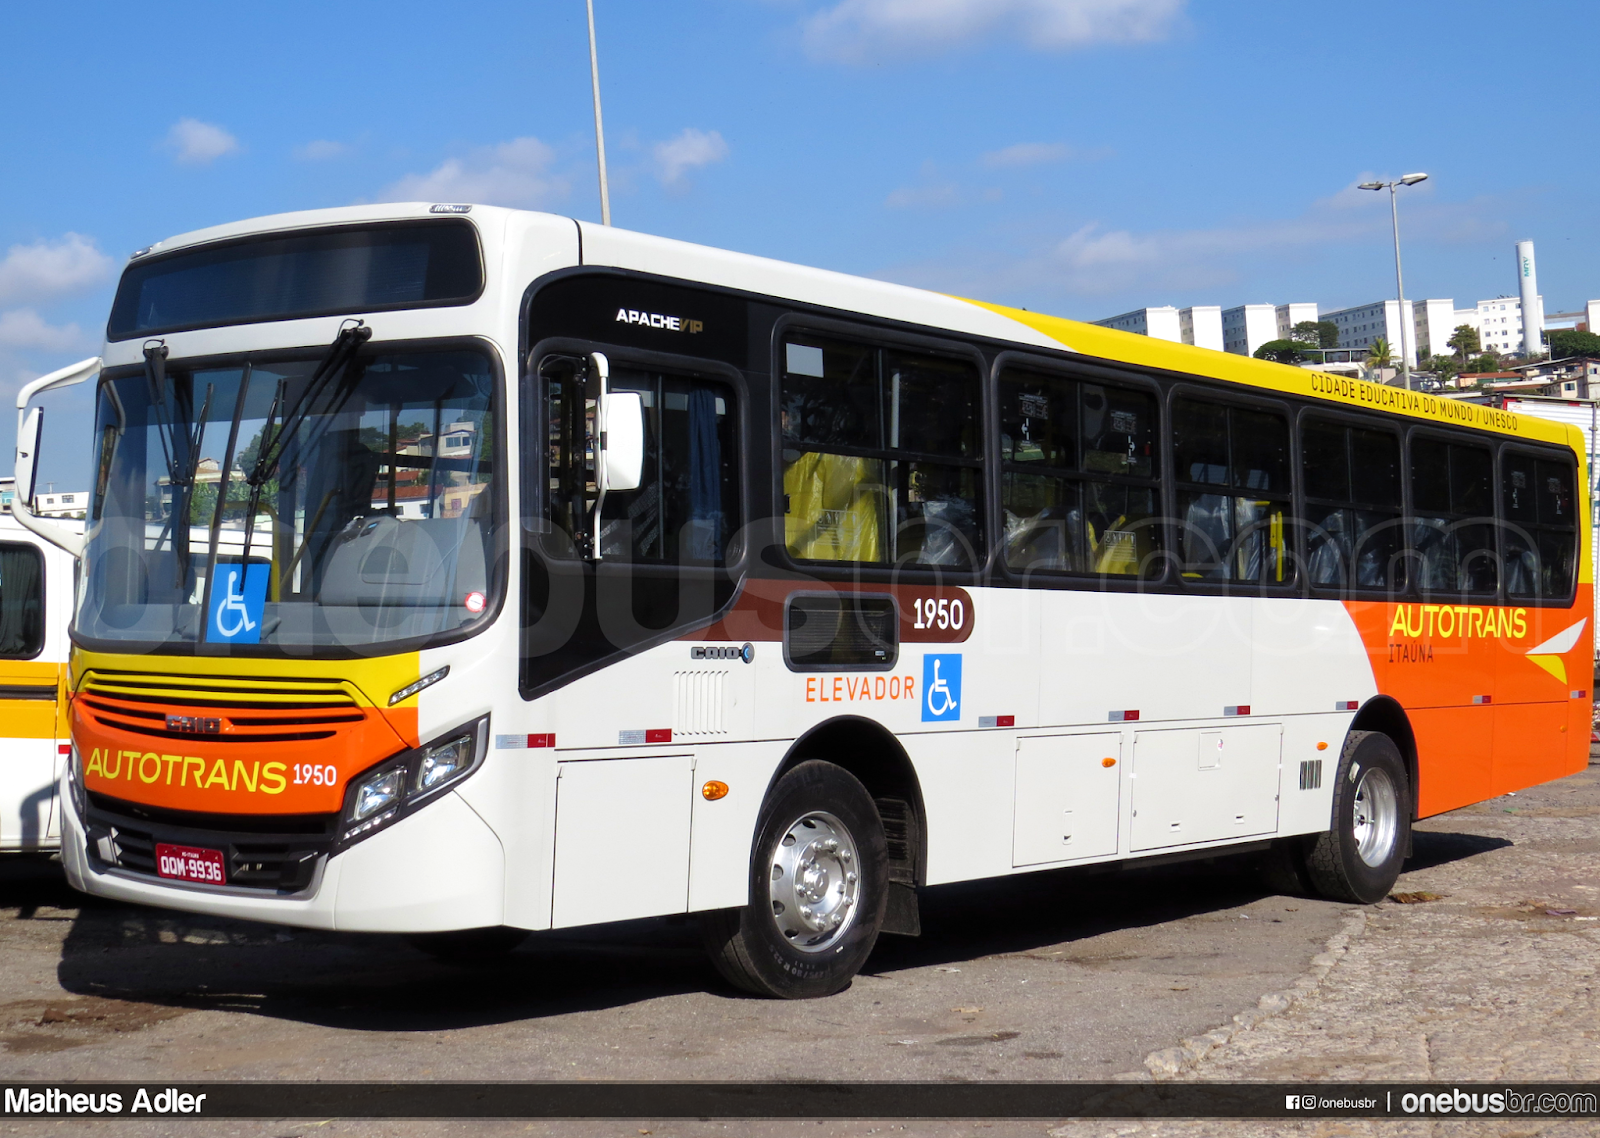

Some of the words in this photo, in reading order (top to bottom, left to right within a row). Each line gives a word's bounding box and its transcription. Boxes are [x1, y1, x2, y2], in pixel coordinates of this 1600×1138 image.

[1311, 373, 1355, 398] CIDADE
[1360, 384, 1420, 411] EDUCATIVA
[1423, 397, 1436, 415] DO
[1440, 404, 1473, 422] MUNDO
[1482, 411, 1518, 431] UNESCO
[913, 598, 964, 630] 1950
[1389, 604, 1527, 639] AUTOTRANS
[691, 646, 740, 660] CAIO
[1389, 641, 1434, 663] ITAÚNA
[805, 675, 915, 702] ELEVADOR
[86, 748, 287, 795] AUTOTRANS
[293, 763, 337, 786] 1950
